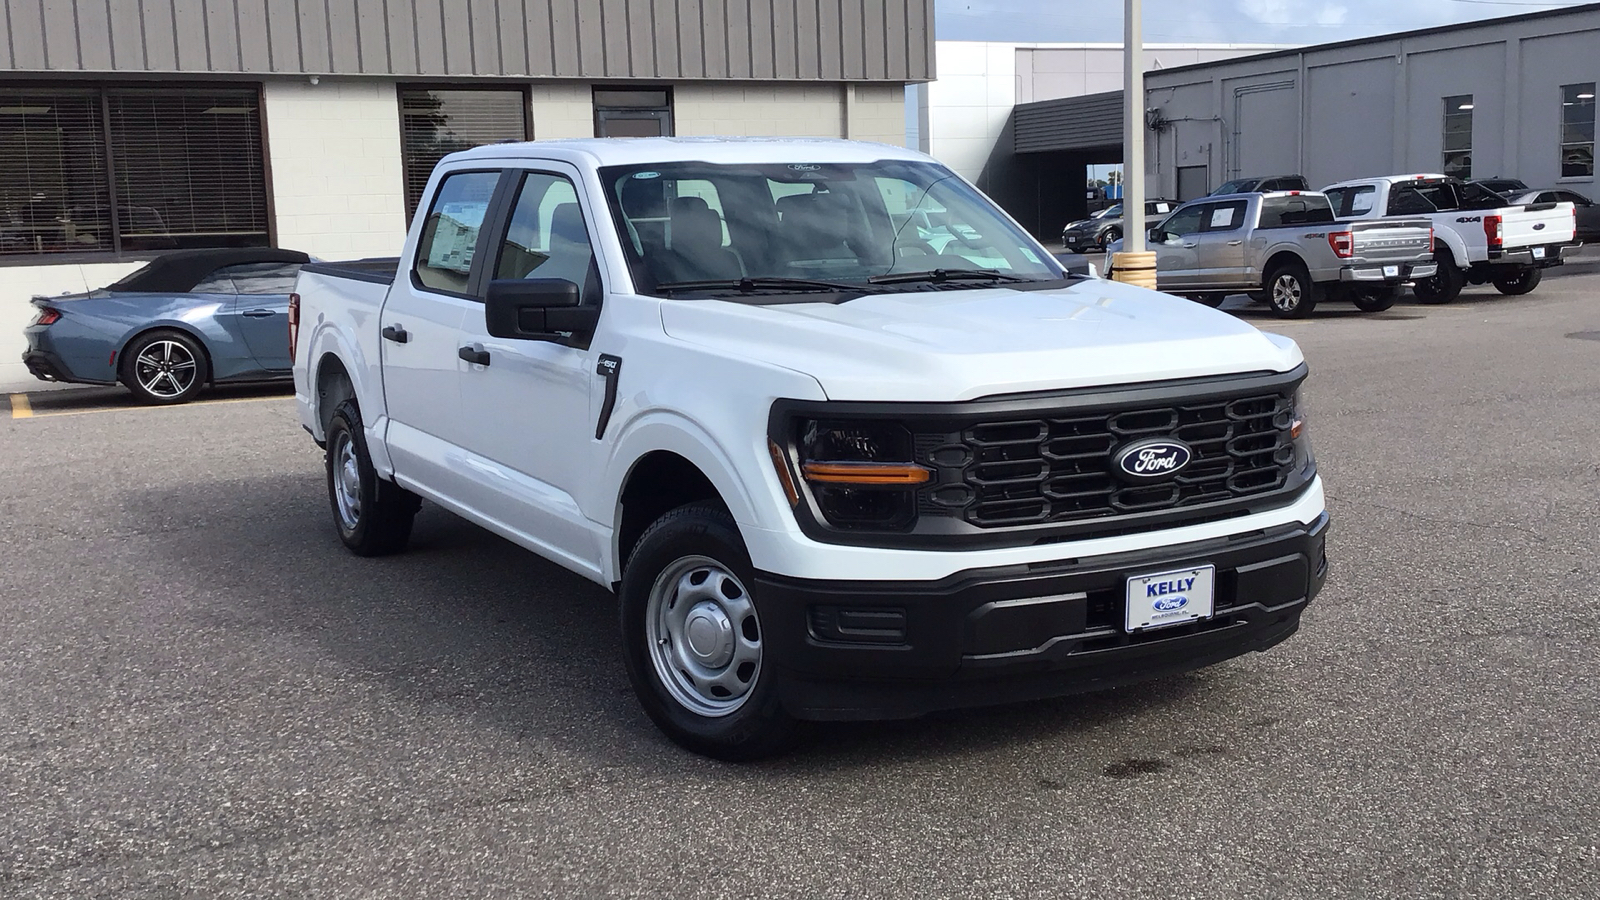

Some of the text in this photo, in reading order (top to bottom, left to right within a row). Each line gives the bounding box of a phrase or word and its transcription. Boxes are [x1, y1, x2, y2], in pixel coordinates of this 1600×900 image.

[1134, 448, 1178, 472] Ford
[1147, 577, 1195, 597] KELLY
[1160, 597, 1182, 610] Ford
